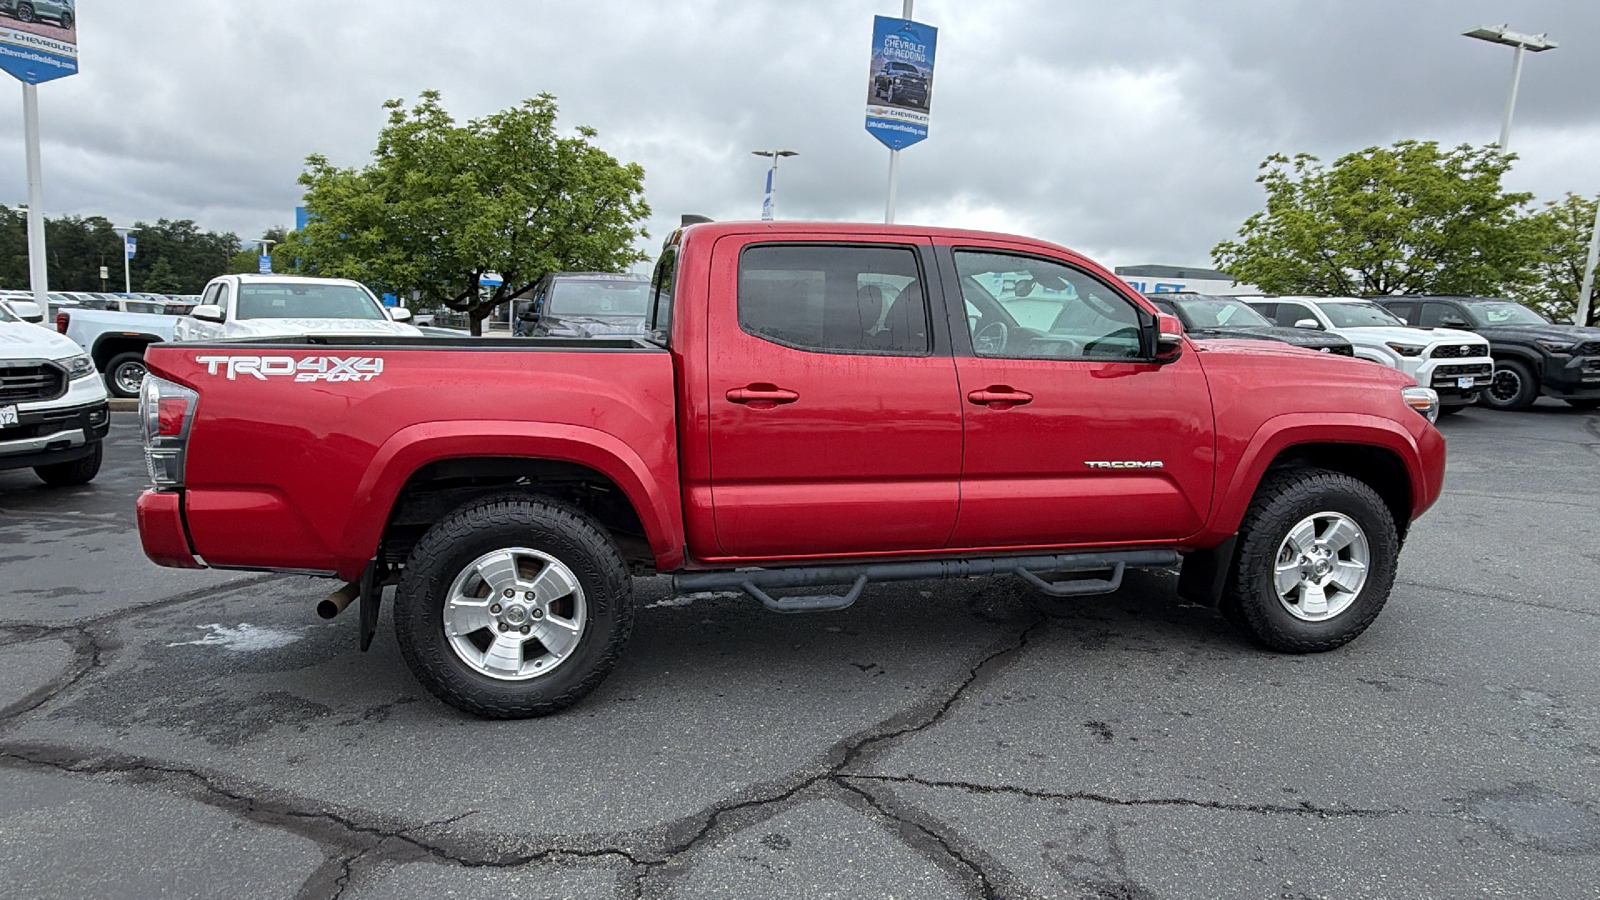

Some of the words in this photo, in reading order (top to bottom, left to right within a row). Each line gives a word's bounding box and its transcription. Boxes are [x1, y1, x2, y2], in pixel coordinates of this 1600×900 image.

[14, 33, 74, 53] CHEVROLET
[884, 38, 926, 54] CHEVROLET
[883, 47, 895, 56] OF
[895, 48, 926, 63] REDDING
[890, 110, 928, 122] CHEVROLET
[195, 355, 298, 381] TRD
[294, 372, 380, 382] SPORT
[1084, 461, 1163, 469] TACOMA
